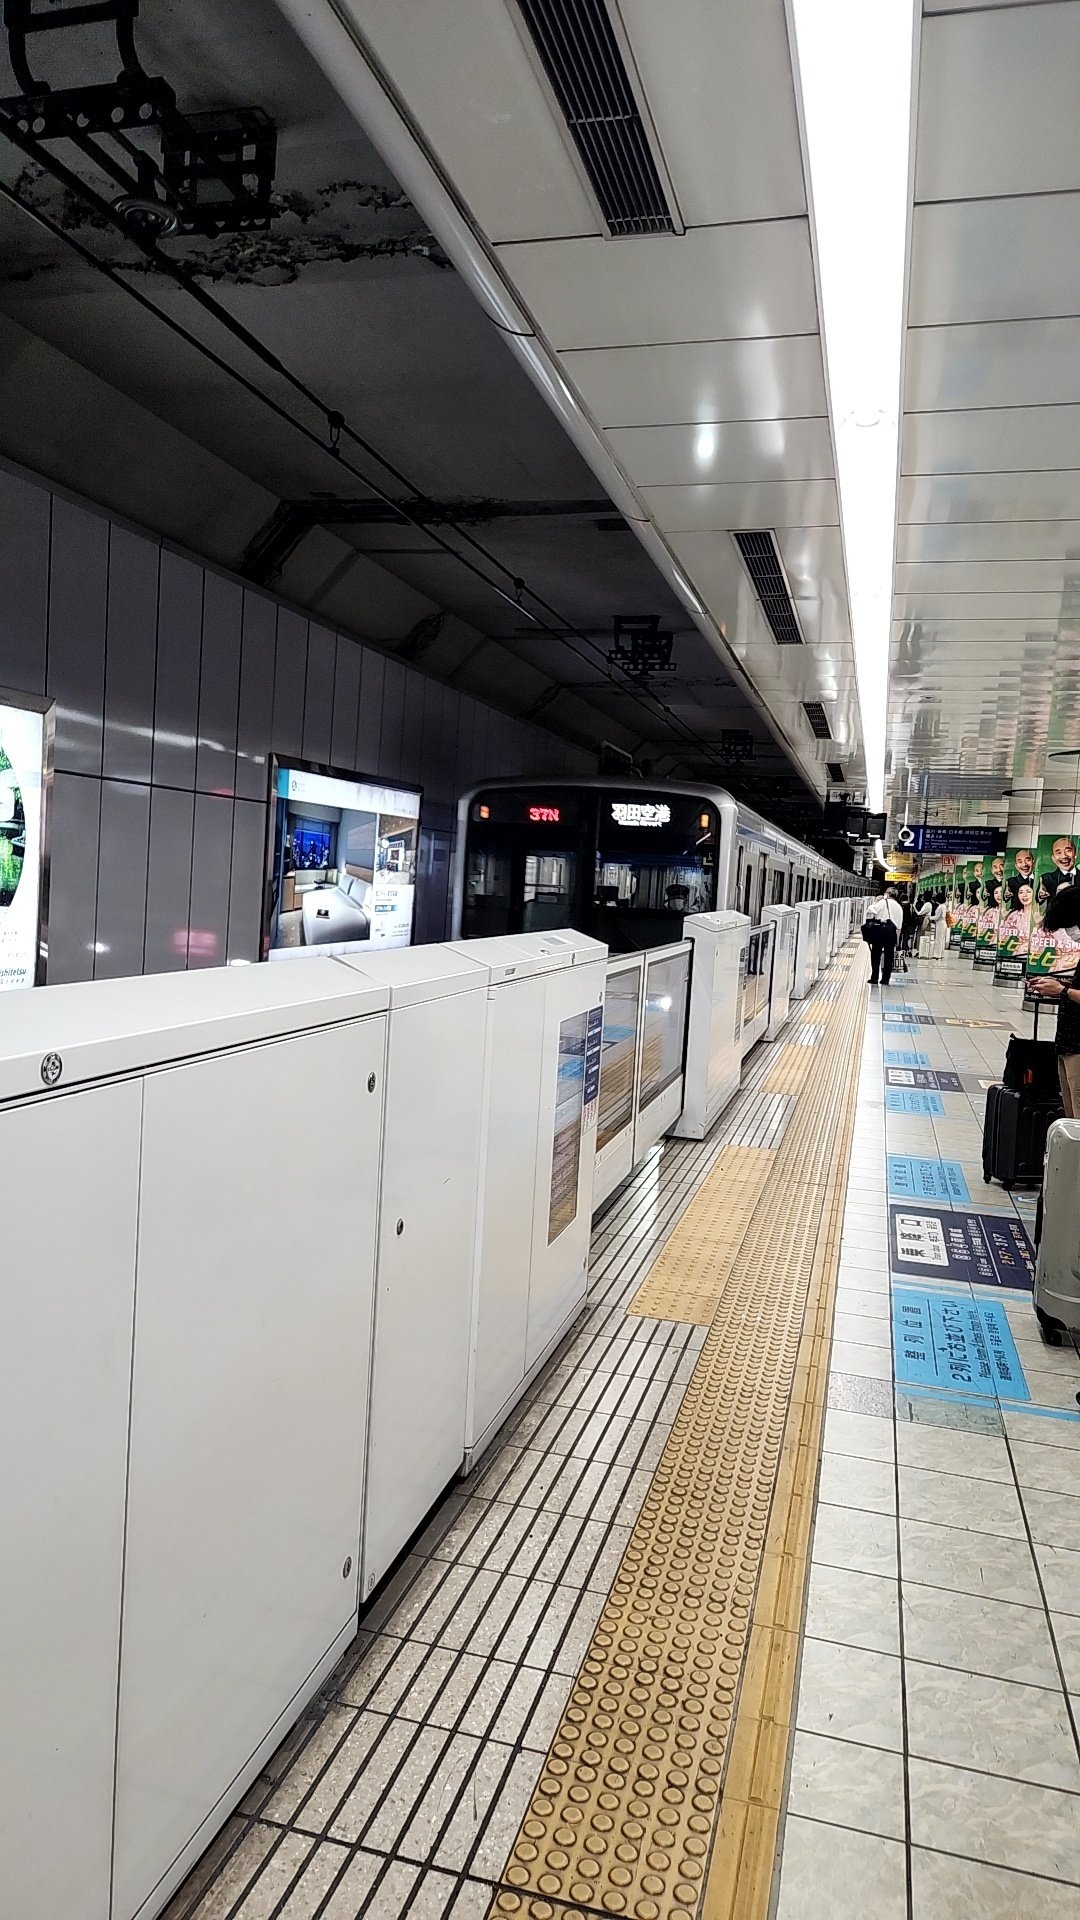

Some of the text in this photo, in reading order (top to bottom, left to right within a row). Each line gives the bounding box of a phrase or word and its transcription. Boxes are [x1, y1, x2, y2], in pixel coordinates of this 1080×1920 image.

[529, 807, 560, 822] 37N
[611, 803, 671, 823] 羽田空港
[1031, 937, 1055, 948] SPEED
[1057, 939, 1064, 949] &
[901, 1305, 927, 1361] 整列位置
[938, 1300, 972, 1383] 2列にお並び下さい
